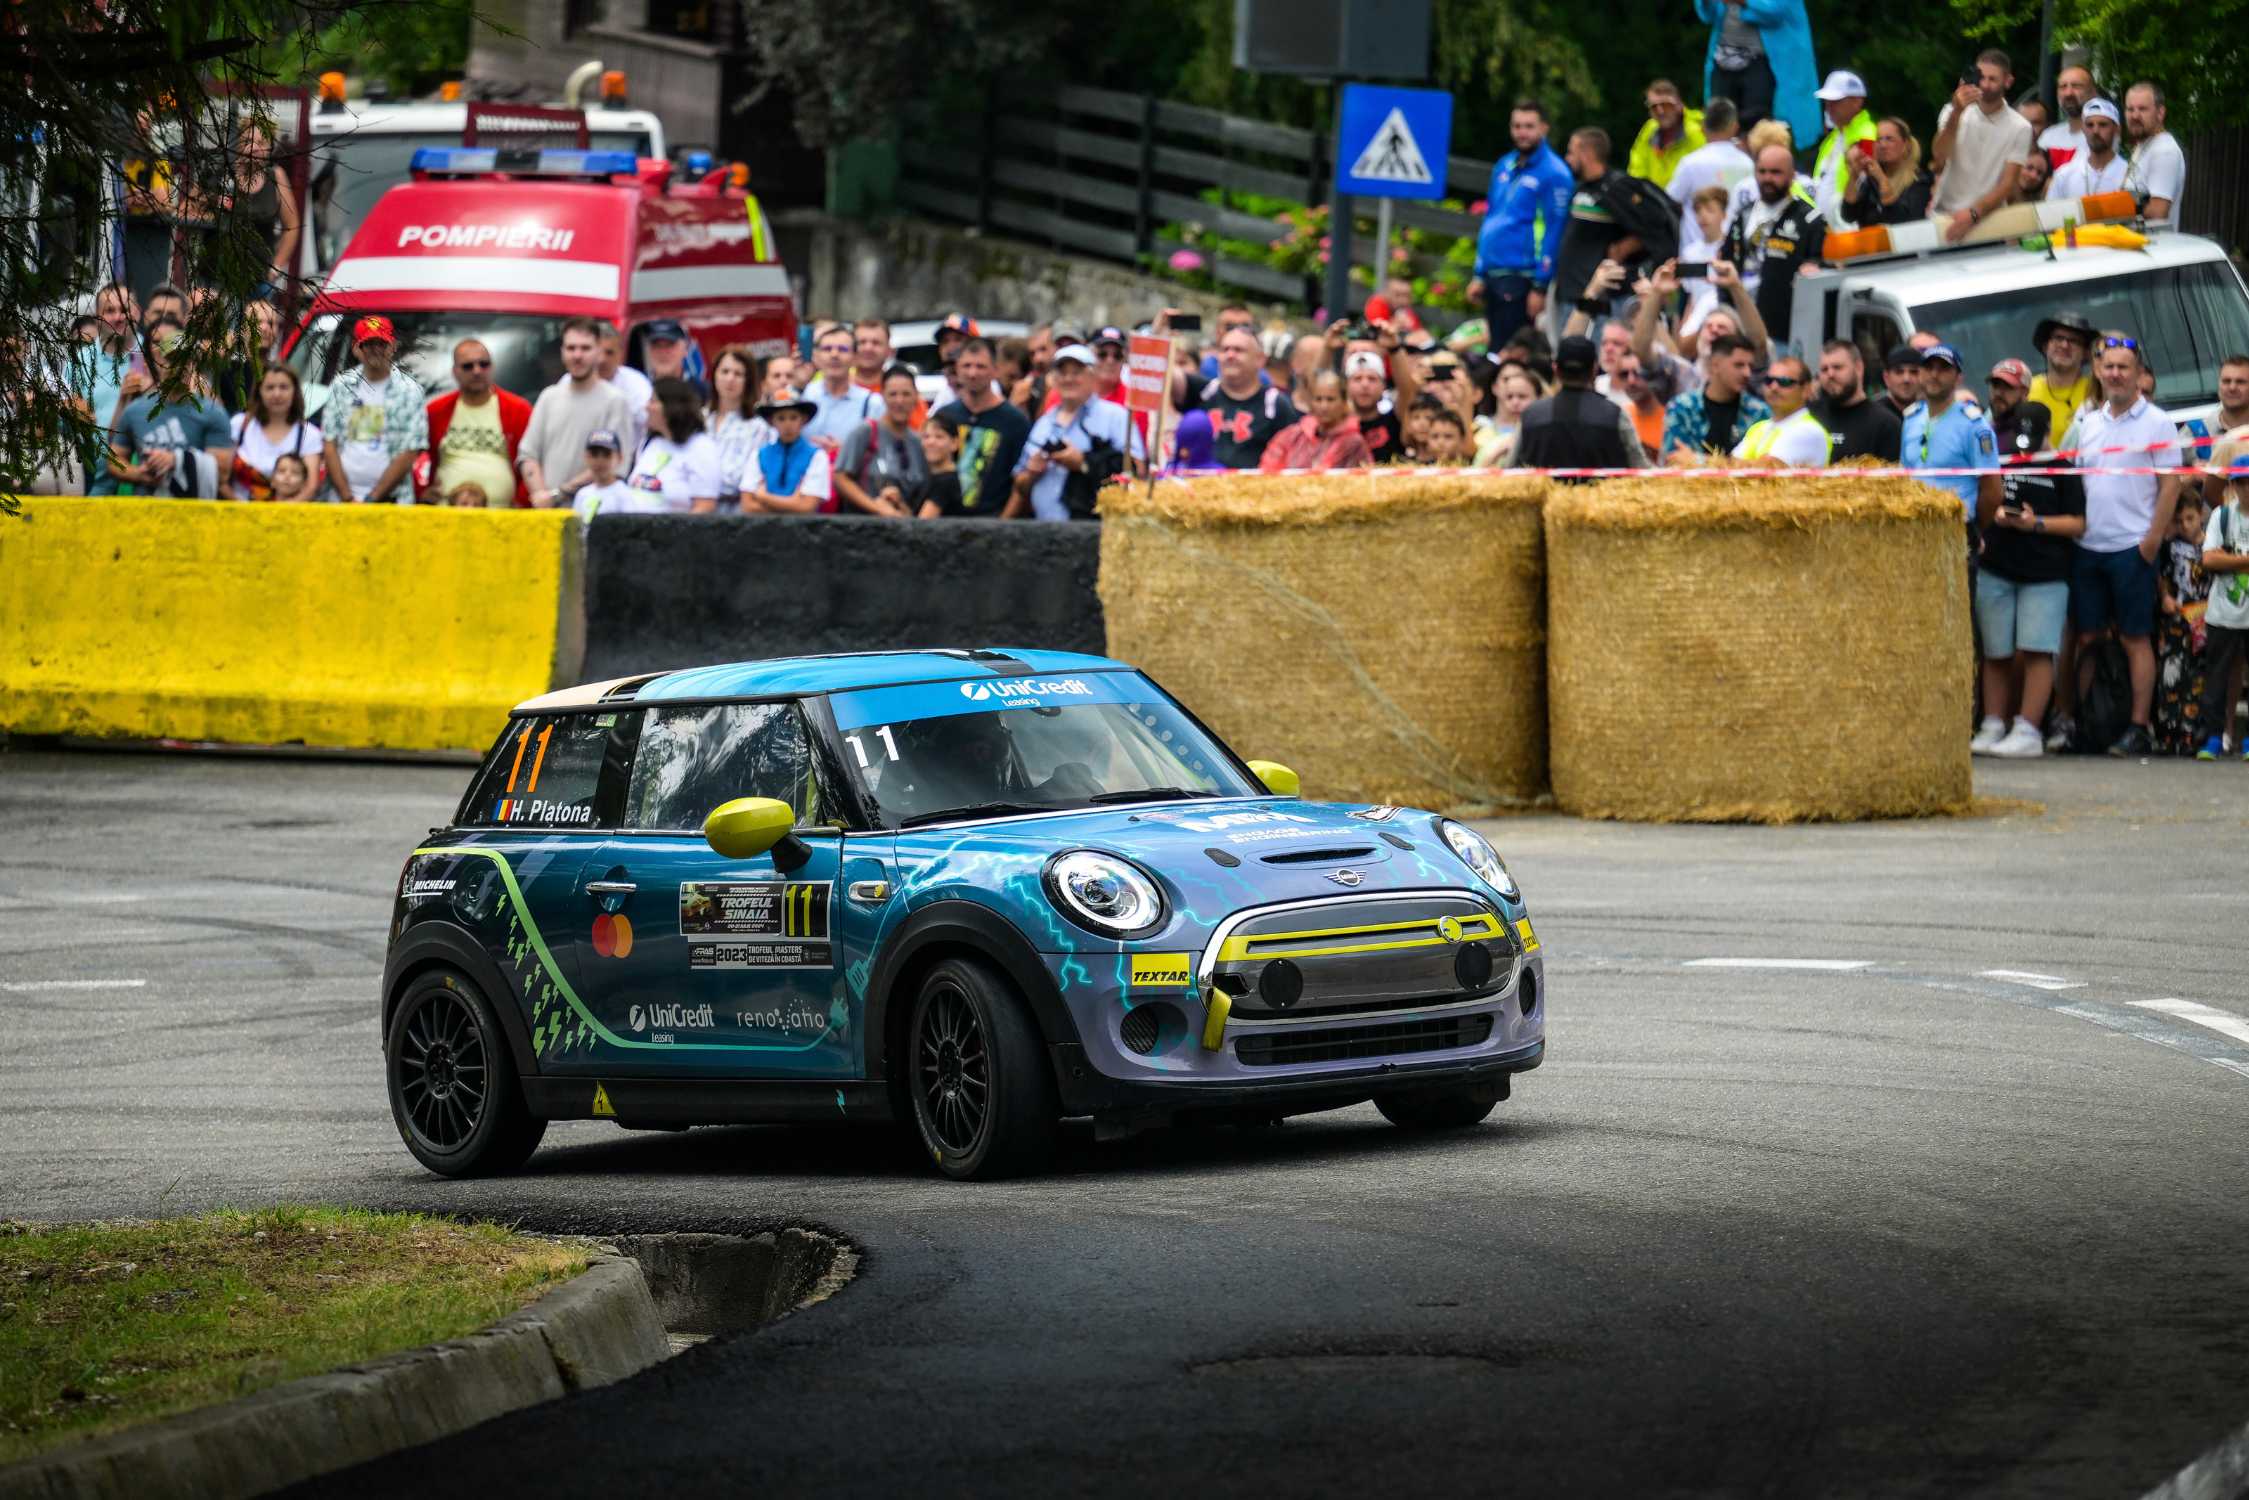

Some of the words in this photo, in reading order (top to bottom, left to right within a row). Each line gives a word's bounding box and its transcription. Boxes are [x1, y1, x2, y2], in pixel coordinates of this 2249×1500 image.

[398, 224, 574, 252] POMPIERII
[987, 679, 1094, 696] UniCredit
[1002, 697, 1040, 707] Leasing
[845, 725, 899, 767] 11
[506, 724, 554, 793] 11
[510, 799, 524, 821] H.
[528, 800, 591, 822] Platona
[414, 880, 456, 890] MICHELIN
[720, 897, 774, 908] TROFEUL
[724, 909, 769, 920] SINAIA
[786, 884, 813, 936] 11
[717, 948, 747, 962] 2023
[748, 945, 772, 954] TROFEUL
[774, 945, 803, 954] MASTERS
[748, 955, 756, 963] DE
[1134, 971, 1188, 982] TEXTAR
[650, 1003, 715, 1028] UniCredit
[651, 1032, 674, 1045] Leasing
